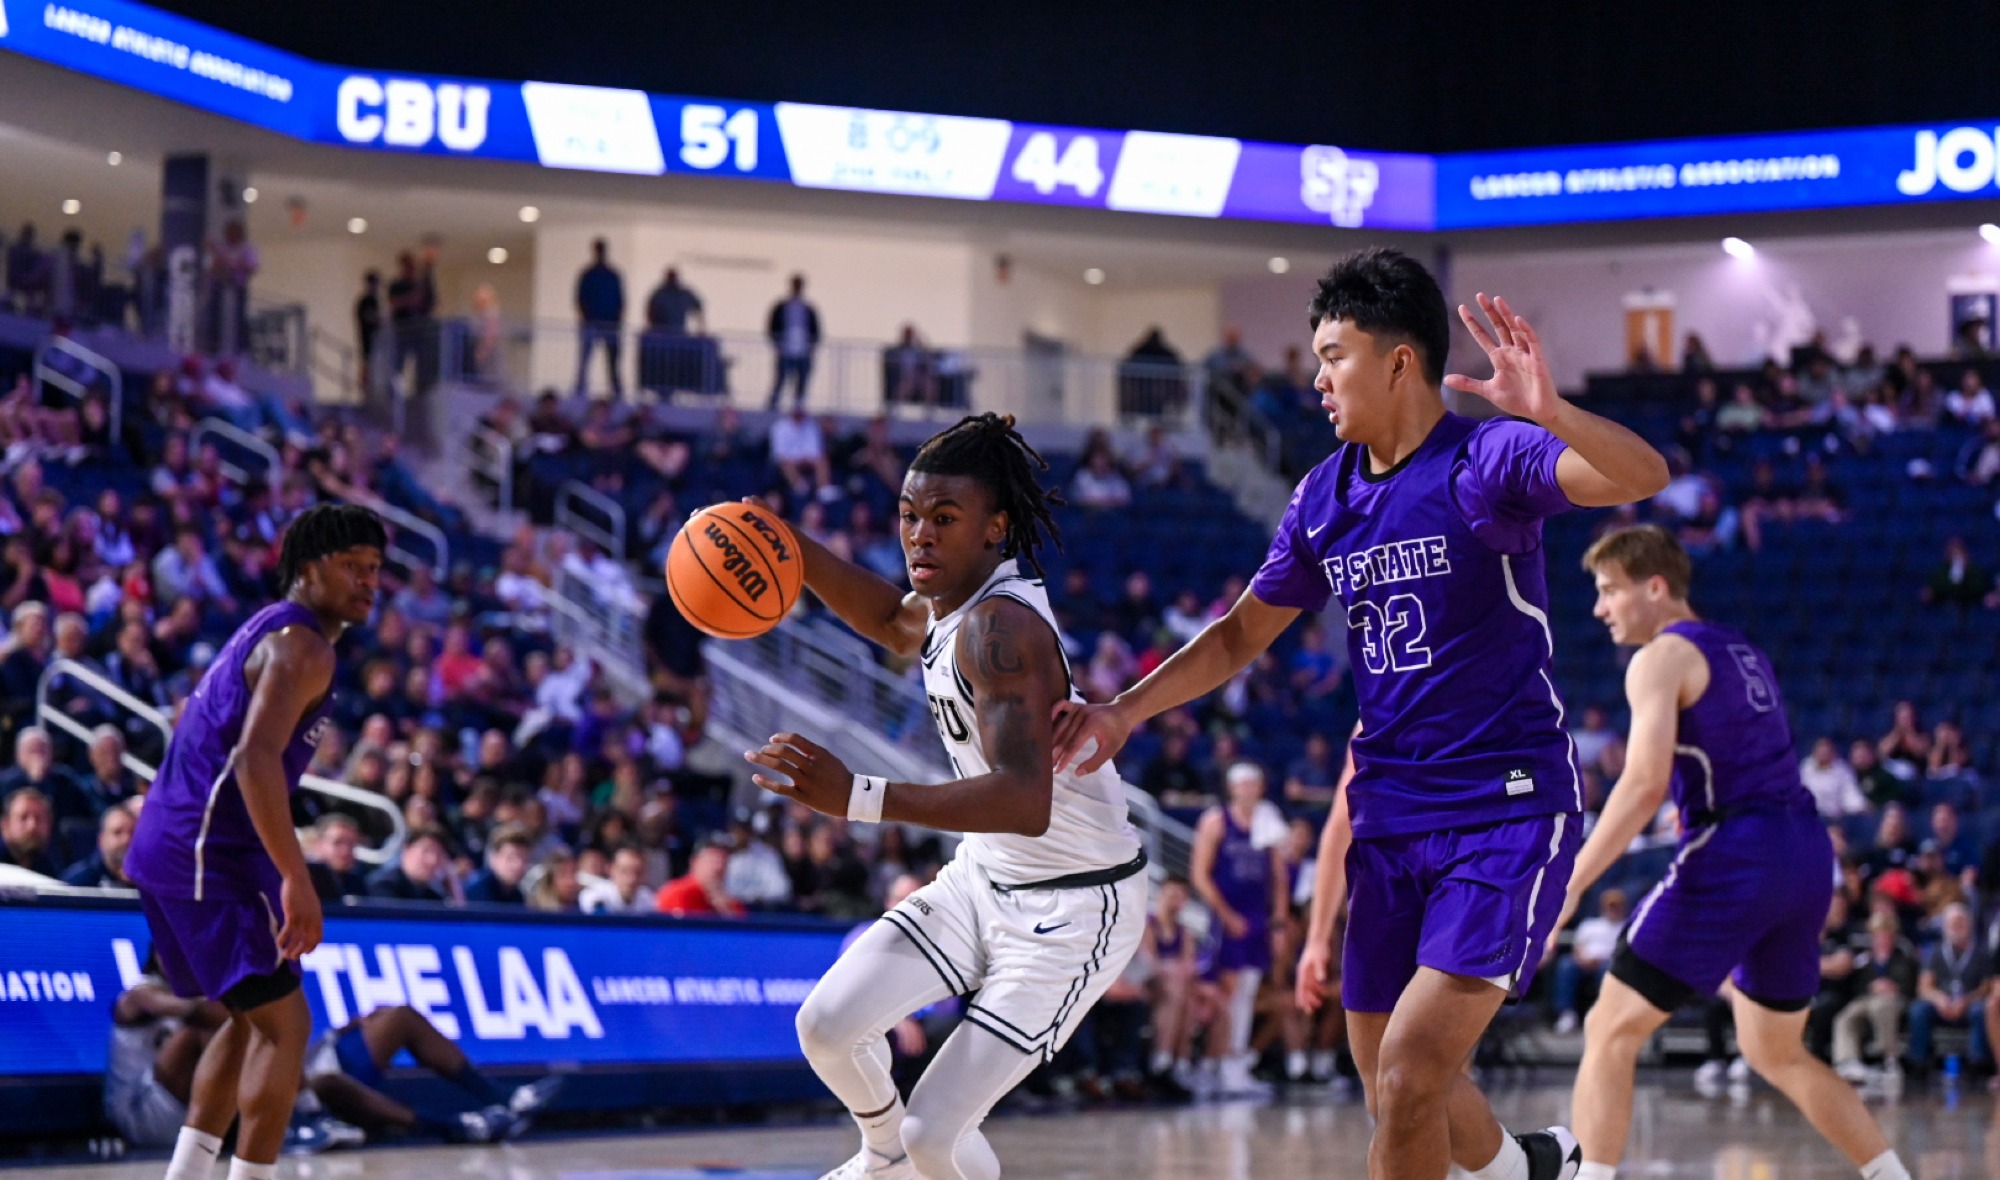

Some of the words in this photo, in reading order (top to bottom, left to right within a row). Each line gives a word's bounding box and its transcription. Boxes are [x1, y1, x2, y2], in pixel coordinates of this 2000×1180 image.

[336, 75, 491, 150] CBU
[679, 104, 759, 173] 51
[1011, 131, 1105, 198] 44
[1679, 154, 1840, 187] ASSOCIATION
[1896, 126, 2000, 195] JO
[704, 522, 768, 602] Wilson
[1319, 556, 1344, 596] F
[1347, 535, 1452, 591] STATE
[1347, 593, 1432, 674] 32
[1725, 643, 1778, 713] 5
[1509, 768, 1527, 780] XL
[300, 943, 461, 1040] THE
[451, 946, 604, 1040] LAA
